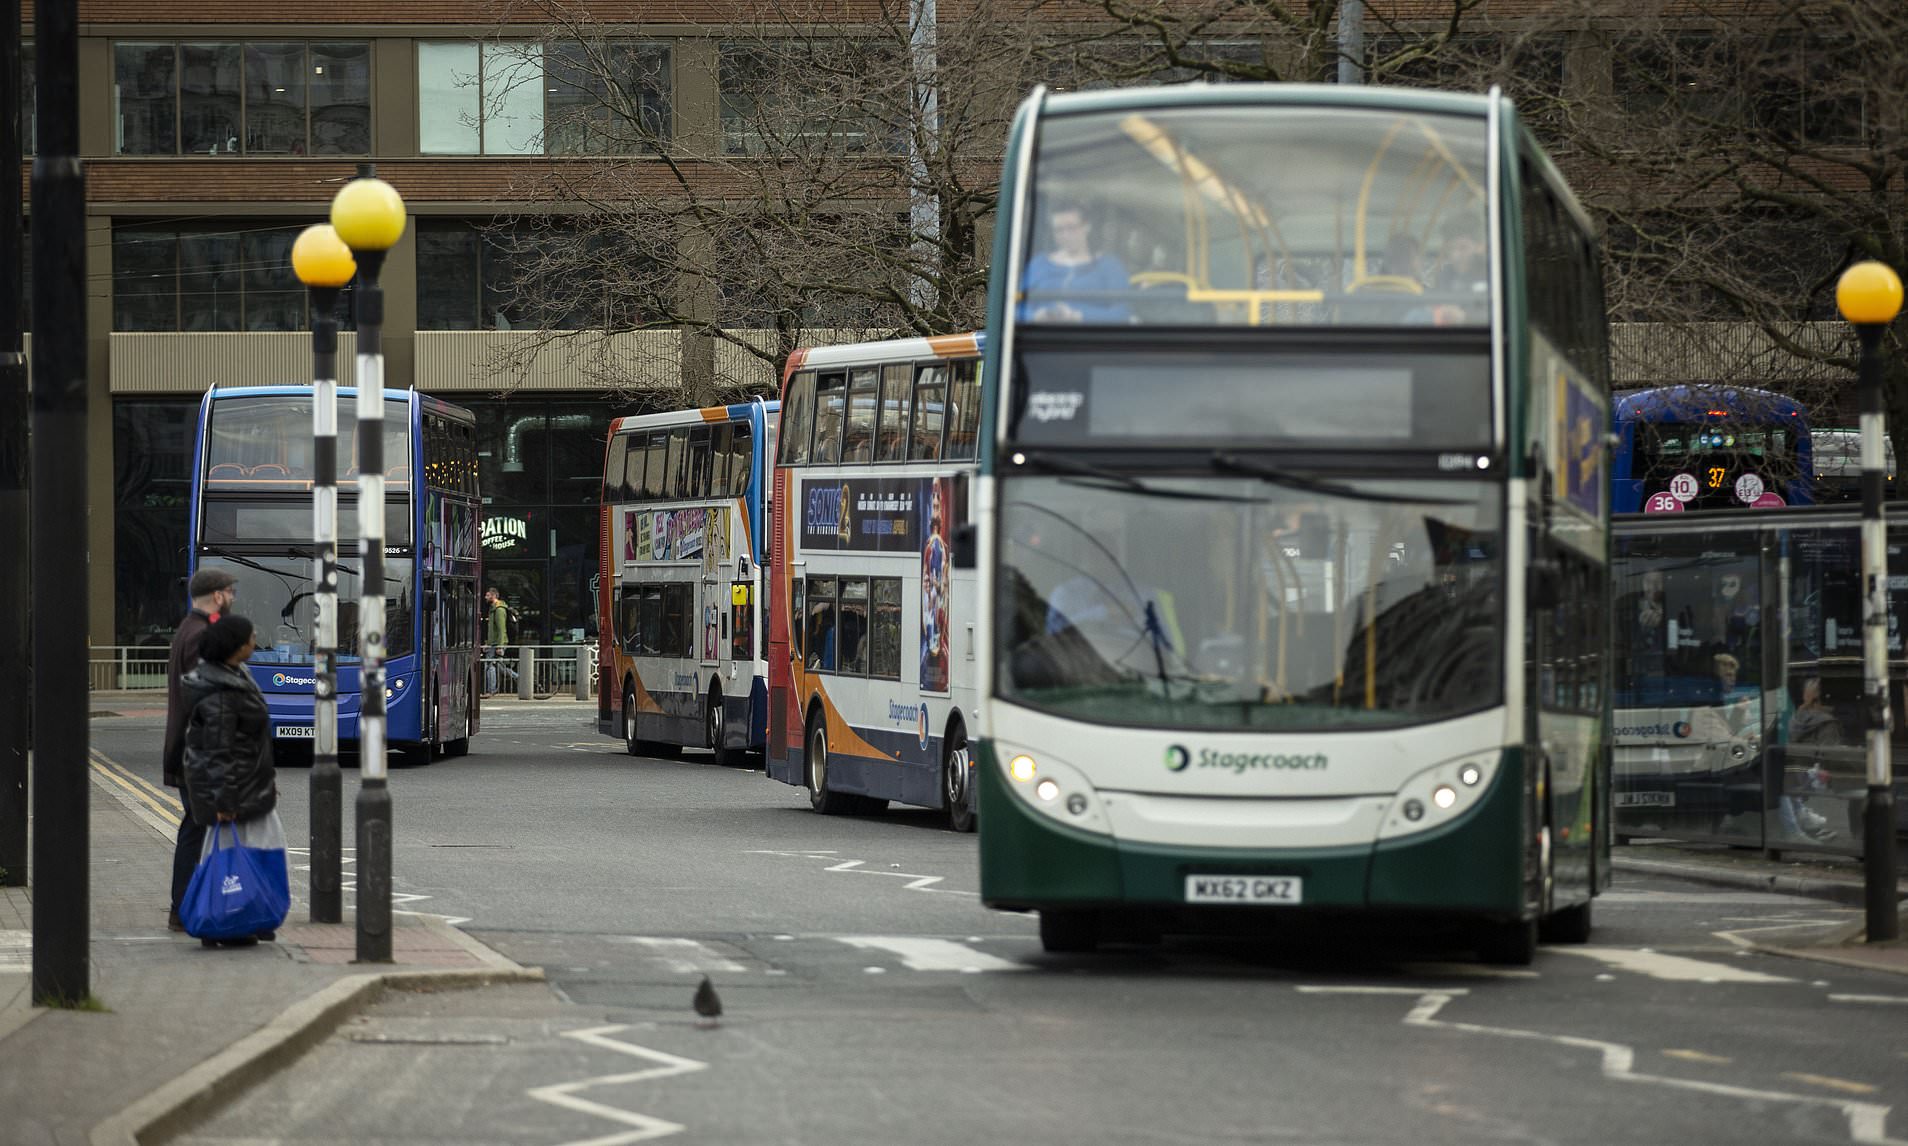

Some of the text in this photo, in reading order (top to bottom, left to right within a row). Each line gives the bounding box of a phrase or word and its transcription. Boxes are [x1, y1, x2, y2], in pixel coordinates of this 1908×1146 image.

[1708, 467, 1726, 488] 37
[1673, 480, 1689, 494] 10
[1654, 496, 1675, 511] 36
[807, 484, 851, 544] SONIC 2
[481, 536, 504, 547] OFFEE
[492, 539, 516, 550] HOUSE
[285, 675, 316, 686] Stageco
[889, 698, 919, 726] Stagecoach
[279, 727, 316, 737] MX09 KT
[1198, 748, 1329, 775] Stagecoach
[1195, 879, 1292, 899] MX62 GKZ
